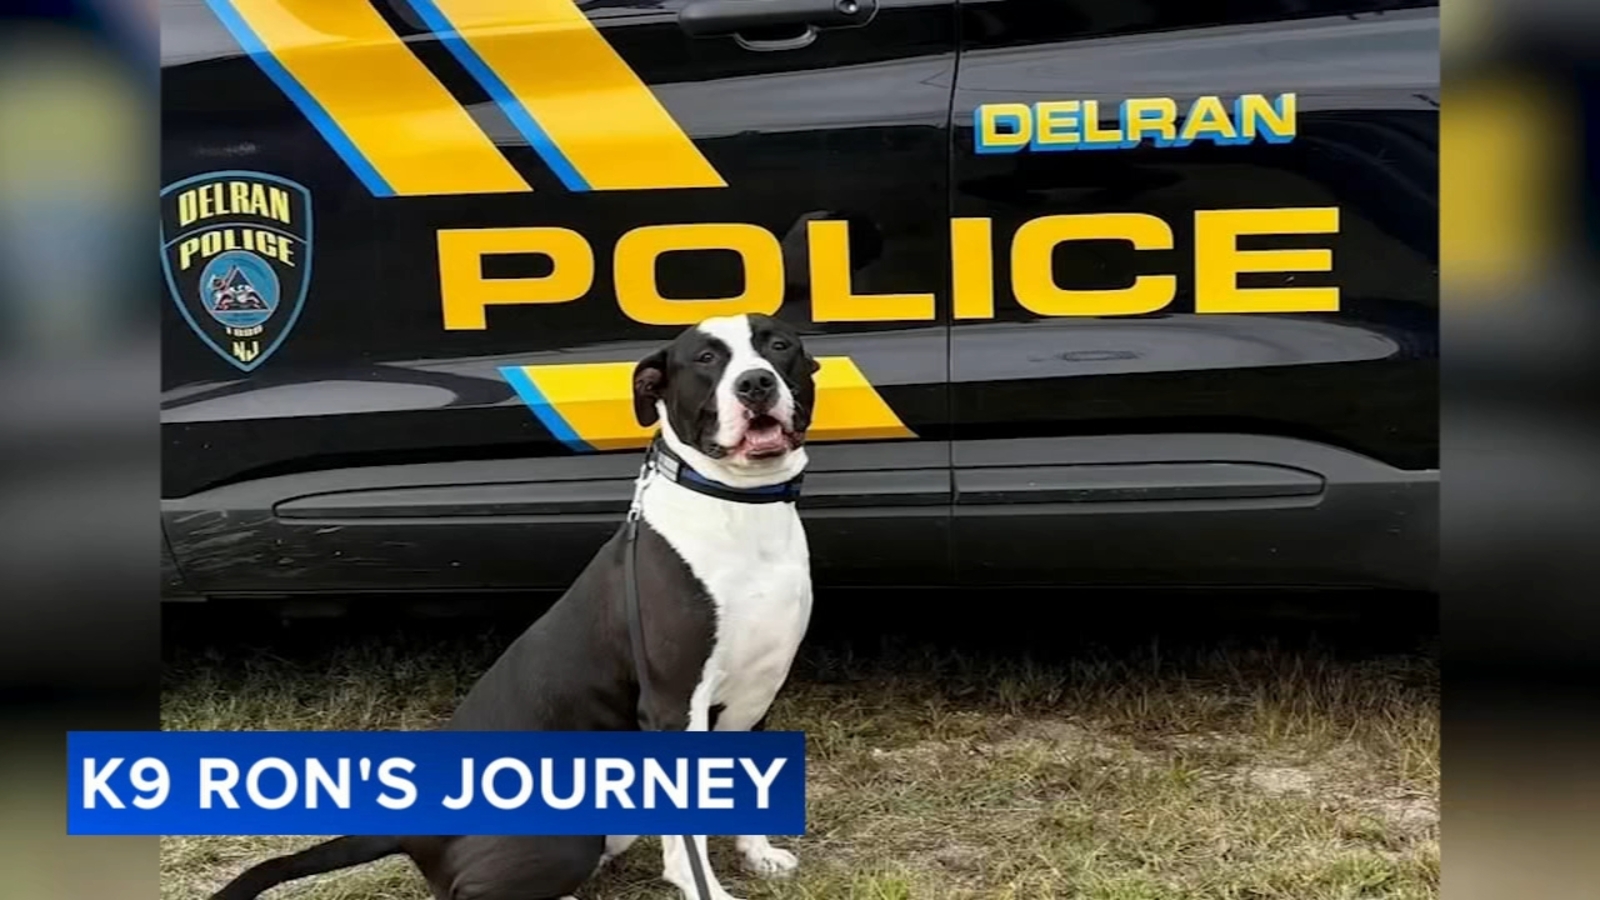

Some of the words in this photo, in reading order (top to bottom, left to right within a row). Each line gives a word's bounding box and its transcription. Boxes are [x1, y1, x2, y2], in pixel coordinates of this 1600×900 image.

[974, 93, 1297, 154] DELRAN
[178, 181, 290, 227] DELRAN
[179, 229, 295, 271] POLICE
[437, 207, 1340, 330] POLICE
[232, 341, 259, 362] NJ
